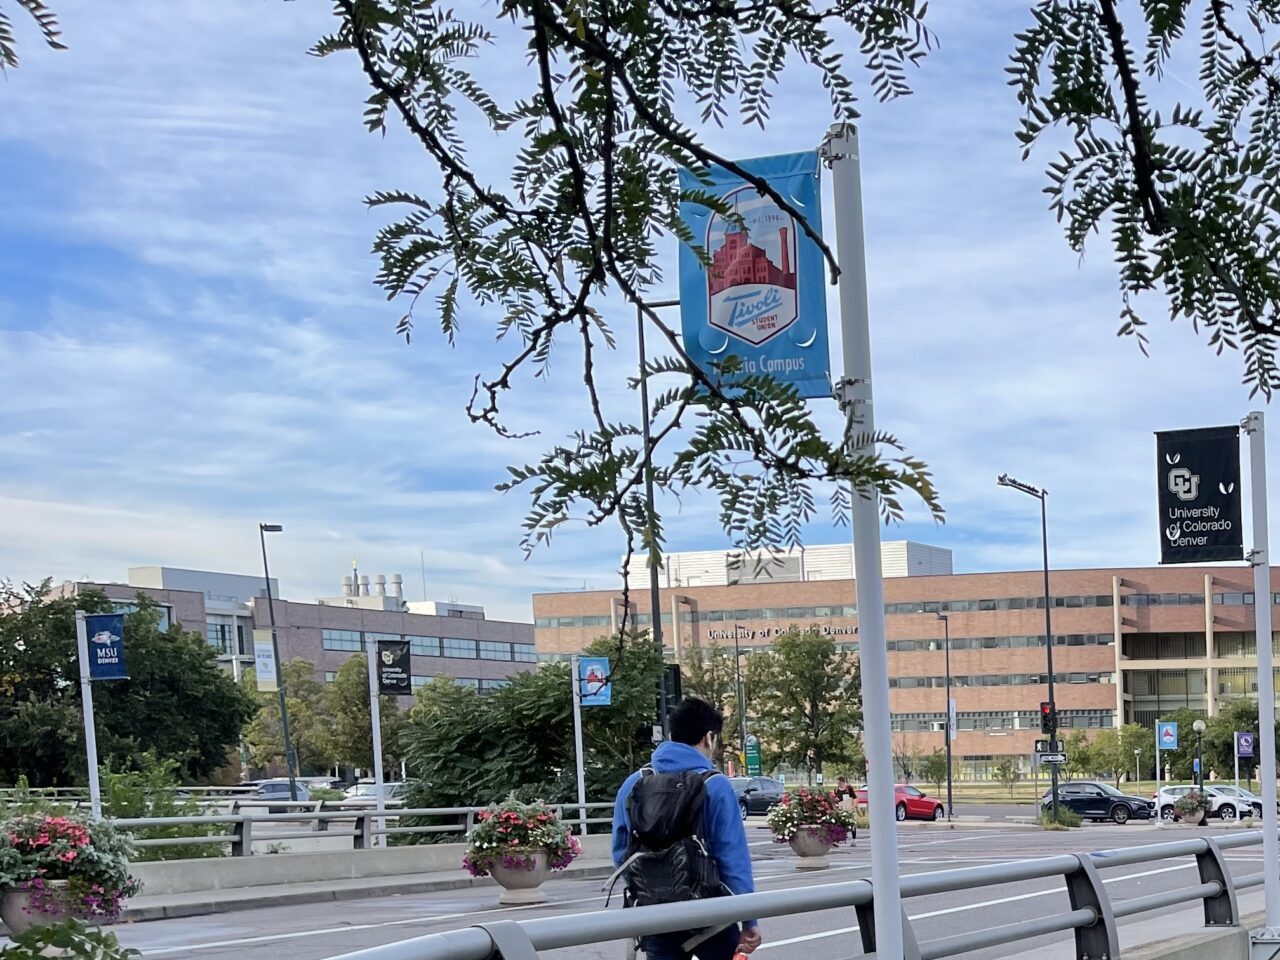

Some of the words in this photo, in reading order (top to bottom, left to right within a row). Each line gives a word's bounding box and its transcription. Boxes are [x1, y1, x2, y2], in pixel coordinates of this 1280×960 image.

[723, 287, 782, 327] Tivoli
[751, 314, 778, 325] STUDENT
[756, 322, 776, 331] UNION
[760, 355, 805, 375] Campus
[1169, 506, 1220, 519] University
[1169, 521, 1181, 533] of
[1183, 519, 1232, 532] Colorado
[1170, 535, 1208, 547] Denver
[759, 628, 770, 638] of
[820, 625, 859, 636] Denver
[96, 647, 118, 658] MSU
[97, 657, 119, 665] DENVER
